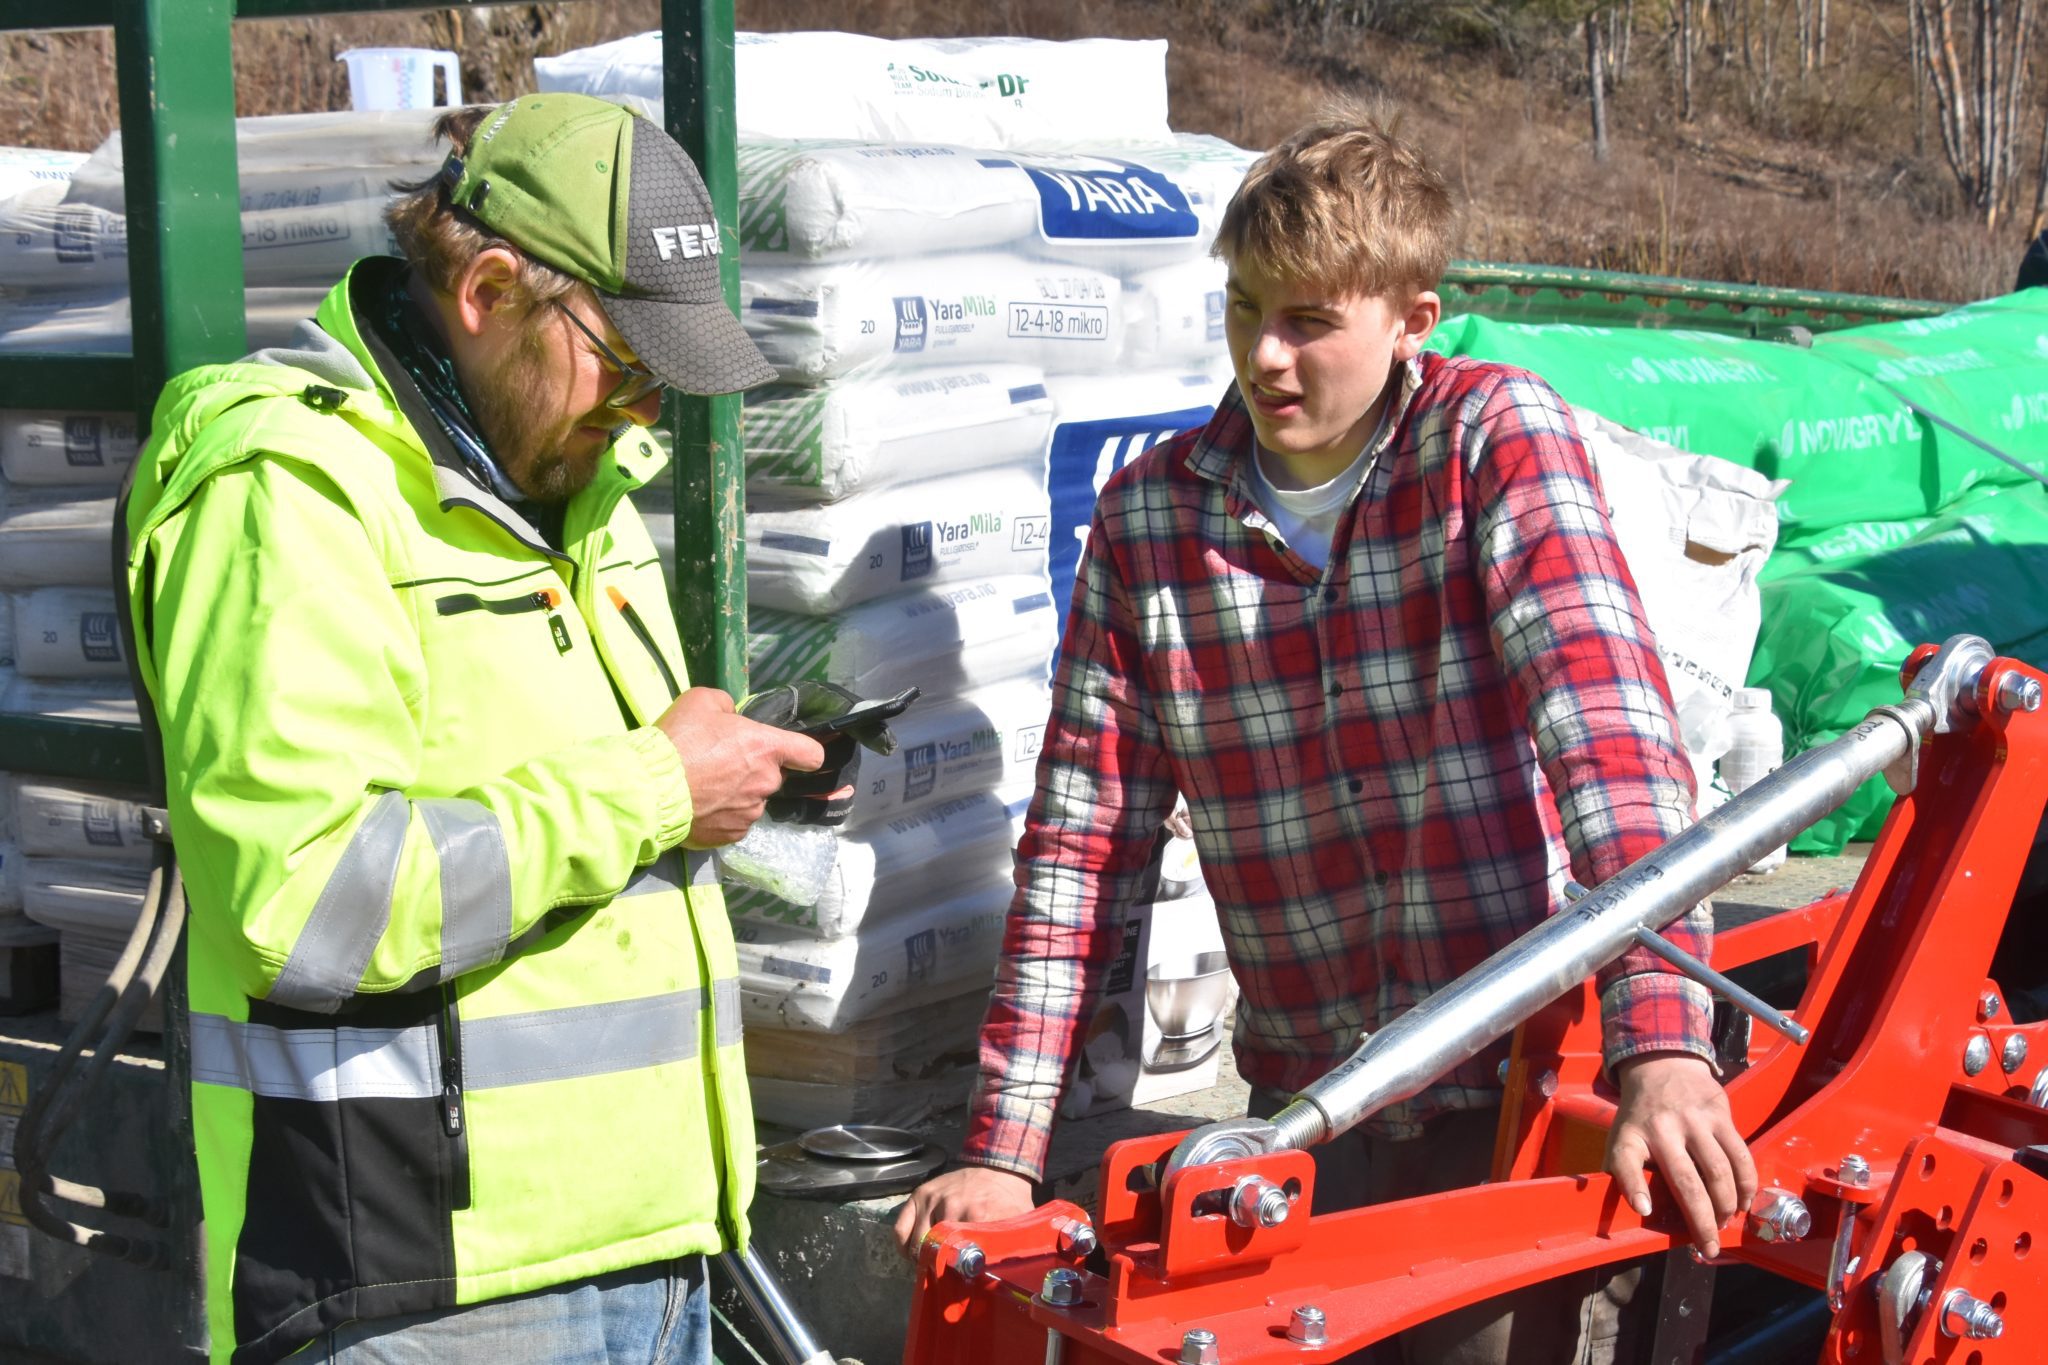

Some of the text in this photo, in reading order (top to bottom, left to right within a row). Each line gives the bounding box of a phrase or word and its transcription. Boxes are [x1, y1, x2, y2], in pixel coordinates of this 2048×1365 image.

[1039, 168, 1177, 215] YARA
[283, 216, 339, 240] mikro
[651, 217, 723, 262] FEN
[928, 295, 997, 321] YaraMila
[860, 320, 876, 334] 20
[1016, 309, 1103, 335] 12-4-18 mikro
[898, 335, 923, 349] YARA
[894, 371, 991, 397] www.yara.no
[1798, 410, 1923, 456] NOVAGRYL
[936, 514, 1002, 544] YaraMila
[869, 553, 884, 570] 20
[902, 582, 998, 619] www.yara.no
[43, 631, 58, 644] 20
[939, 728, 1003, 762] YaraMila
[872, 779, 886, 795] 20
[938, 911, 1004, 947] YaraMila
[872, 971, 888, 989] 20
